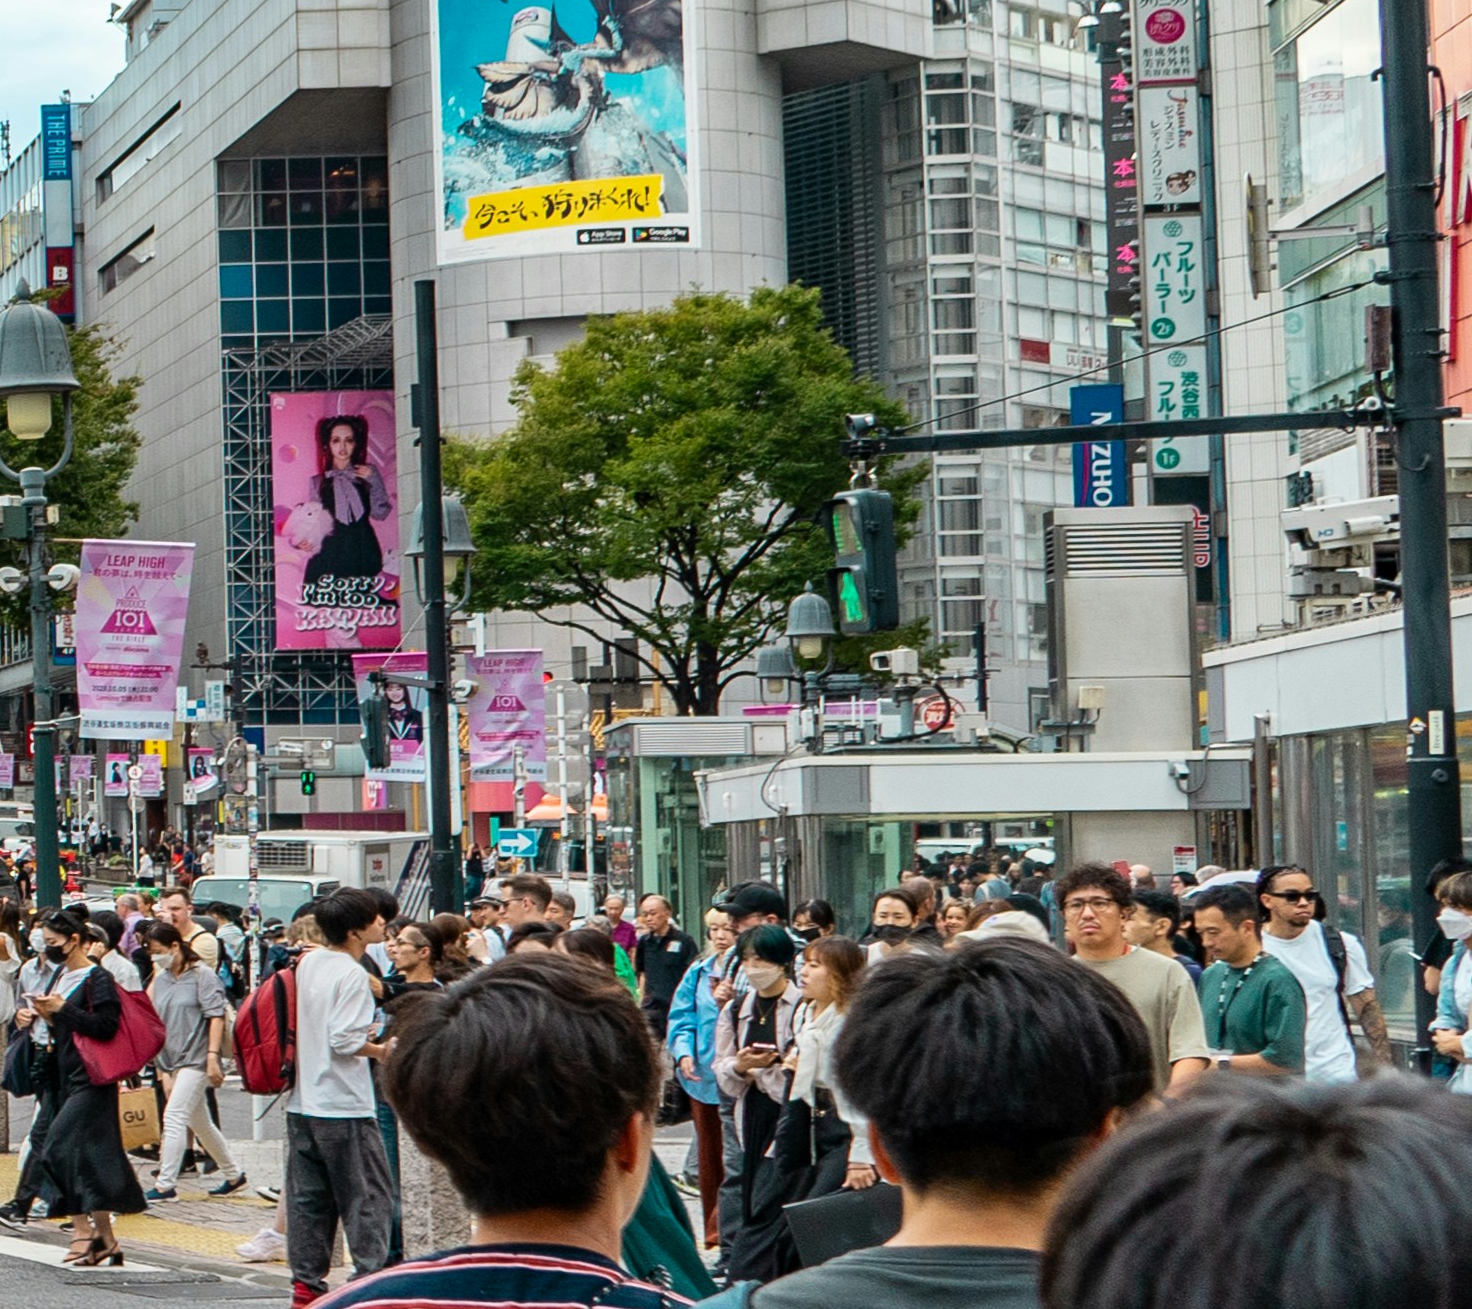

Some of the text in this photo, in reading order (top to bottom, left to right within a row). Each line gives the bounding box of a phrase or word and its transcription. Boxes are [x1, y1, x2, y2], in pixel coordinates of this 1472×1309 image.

[1143, 46, 1191, 58] 形成外科
[1143, 57, 1191, 69] 美容外科
[47, 113, 67, 177] THE PRIME
[1176, 241, 1196, 305] フルーツ
[1151, 252, 1172, 315] パーラー
[1155, 322, 1172, 335] 2F
[1159, 449, 1175, 466] 1F
[108, 555, 166, 569] LEAP HIGH
[317, 574, 396, 594] Sorry,
[116, 598, 147, 609] PRODUCE
[114, 611, 146, 628] 101
[495, 695, 518, 708] 101
